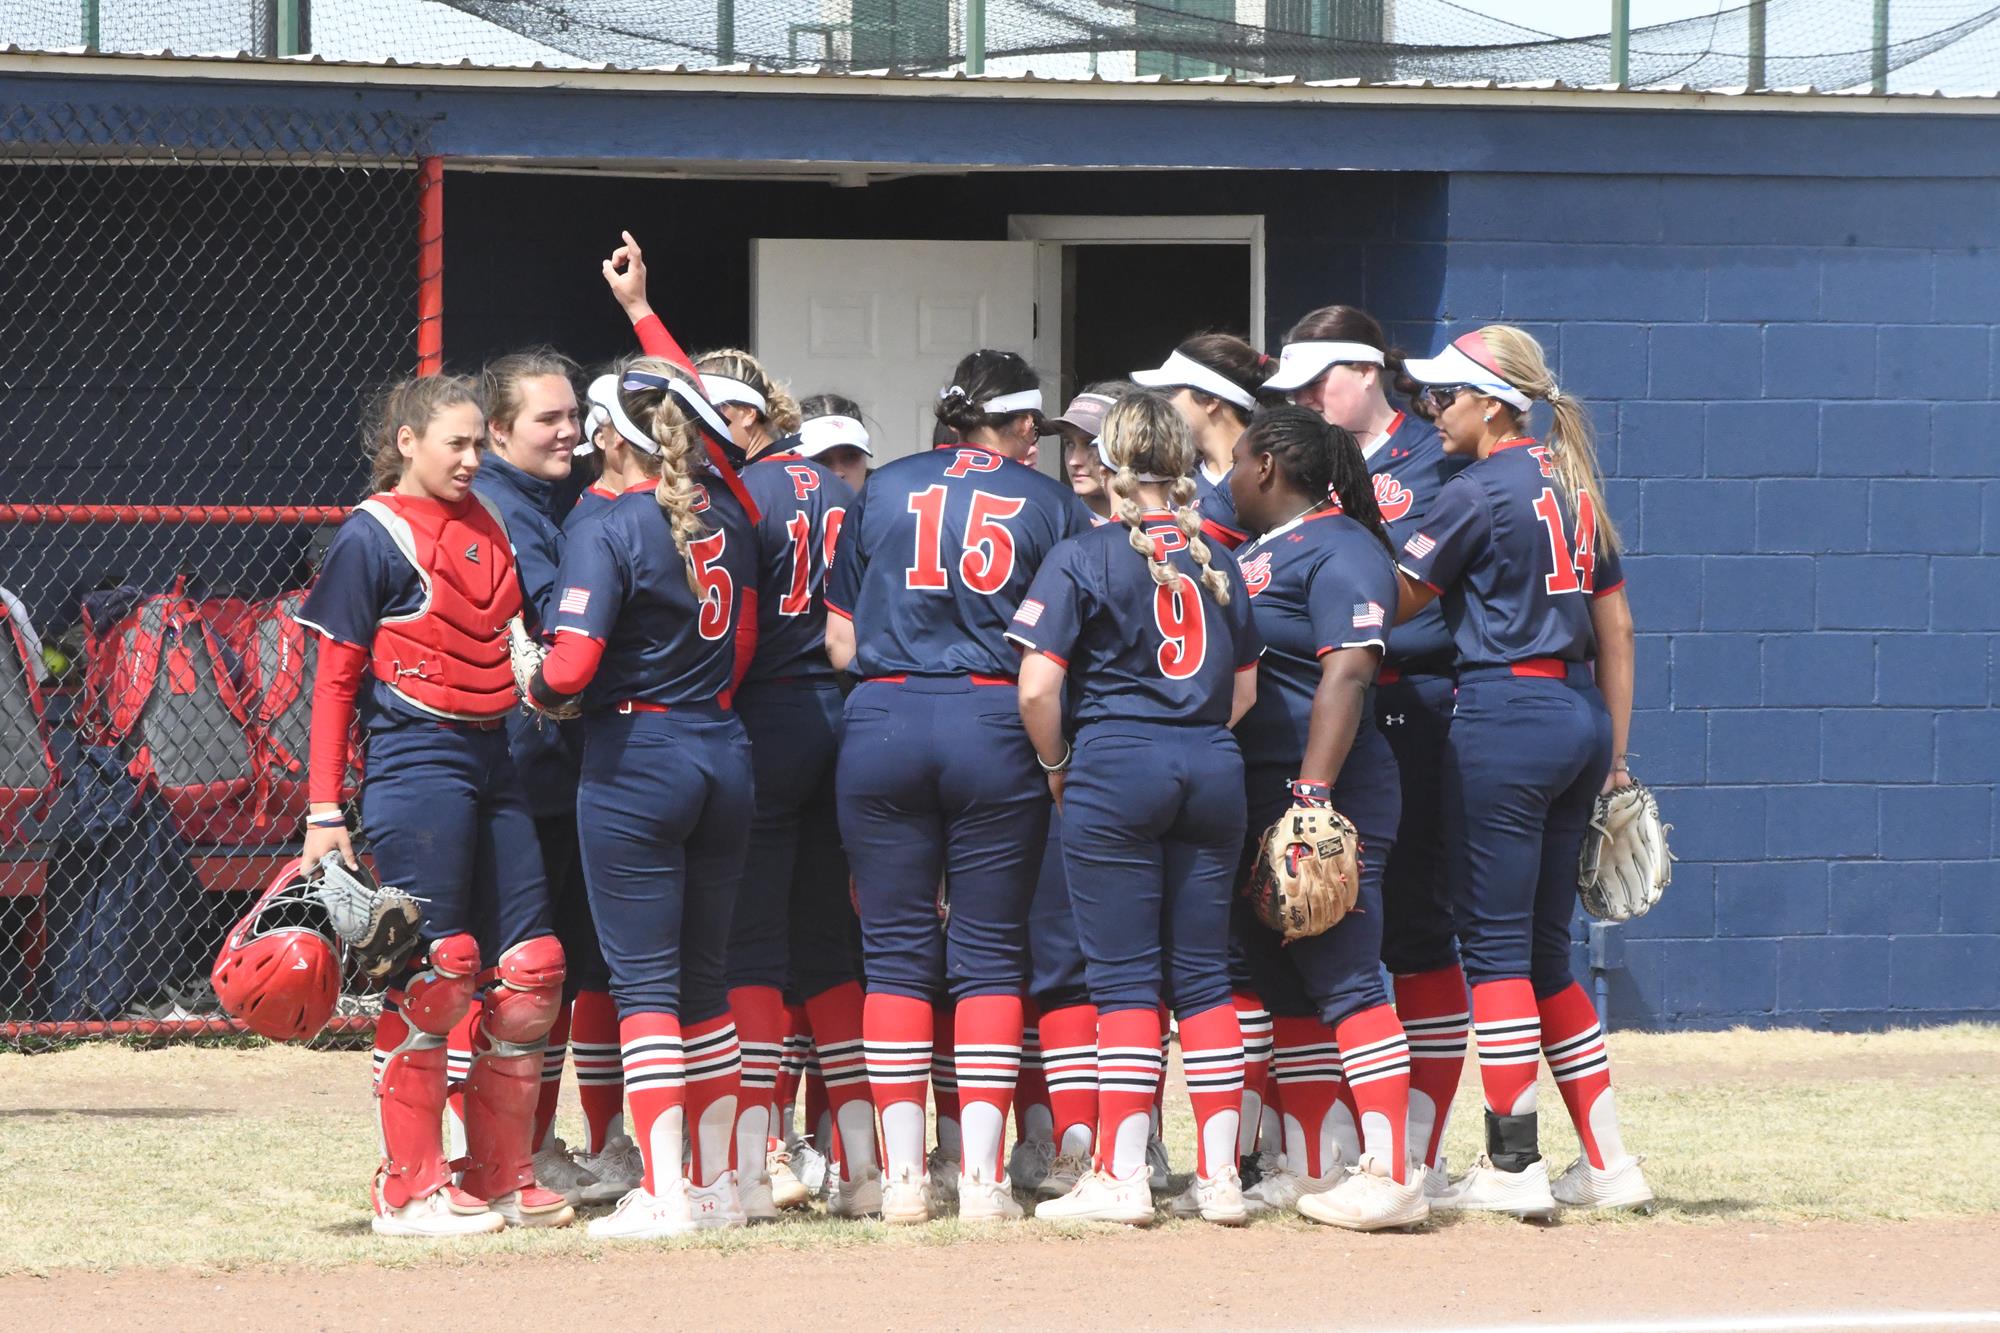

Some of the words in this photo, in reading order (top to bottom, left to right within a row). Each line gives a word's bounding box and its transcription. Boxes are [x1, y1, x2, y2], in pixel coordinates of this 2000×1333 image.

[784, 465, 820, 500] P
[943, 449, 1004, 479] P
[686, 527, 734, 641] 5
[906, 484, 1027, 595] 15
[1145, 525, 1189, 564] P
[1532, 487, 1597, 595] 14
[1153, 573, 1207, 680] 9
